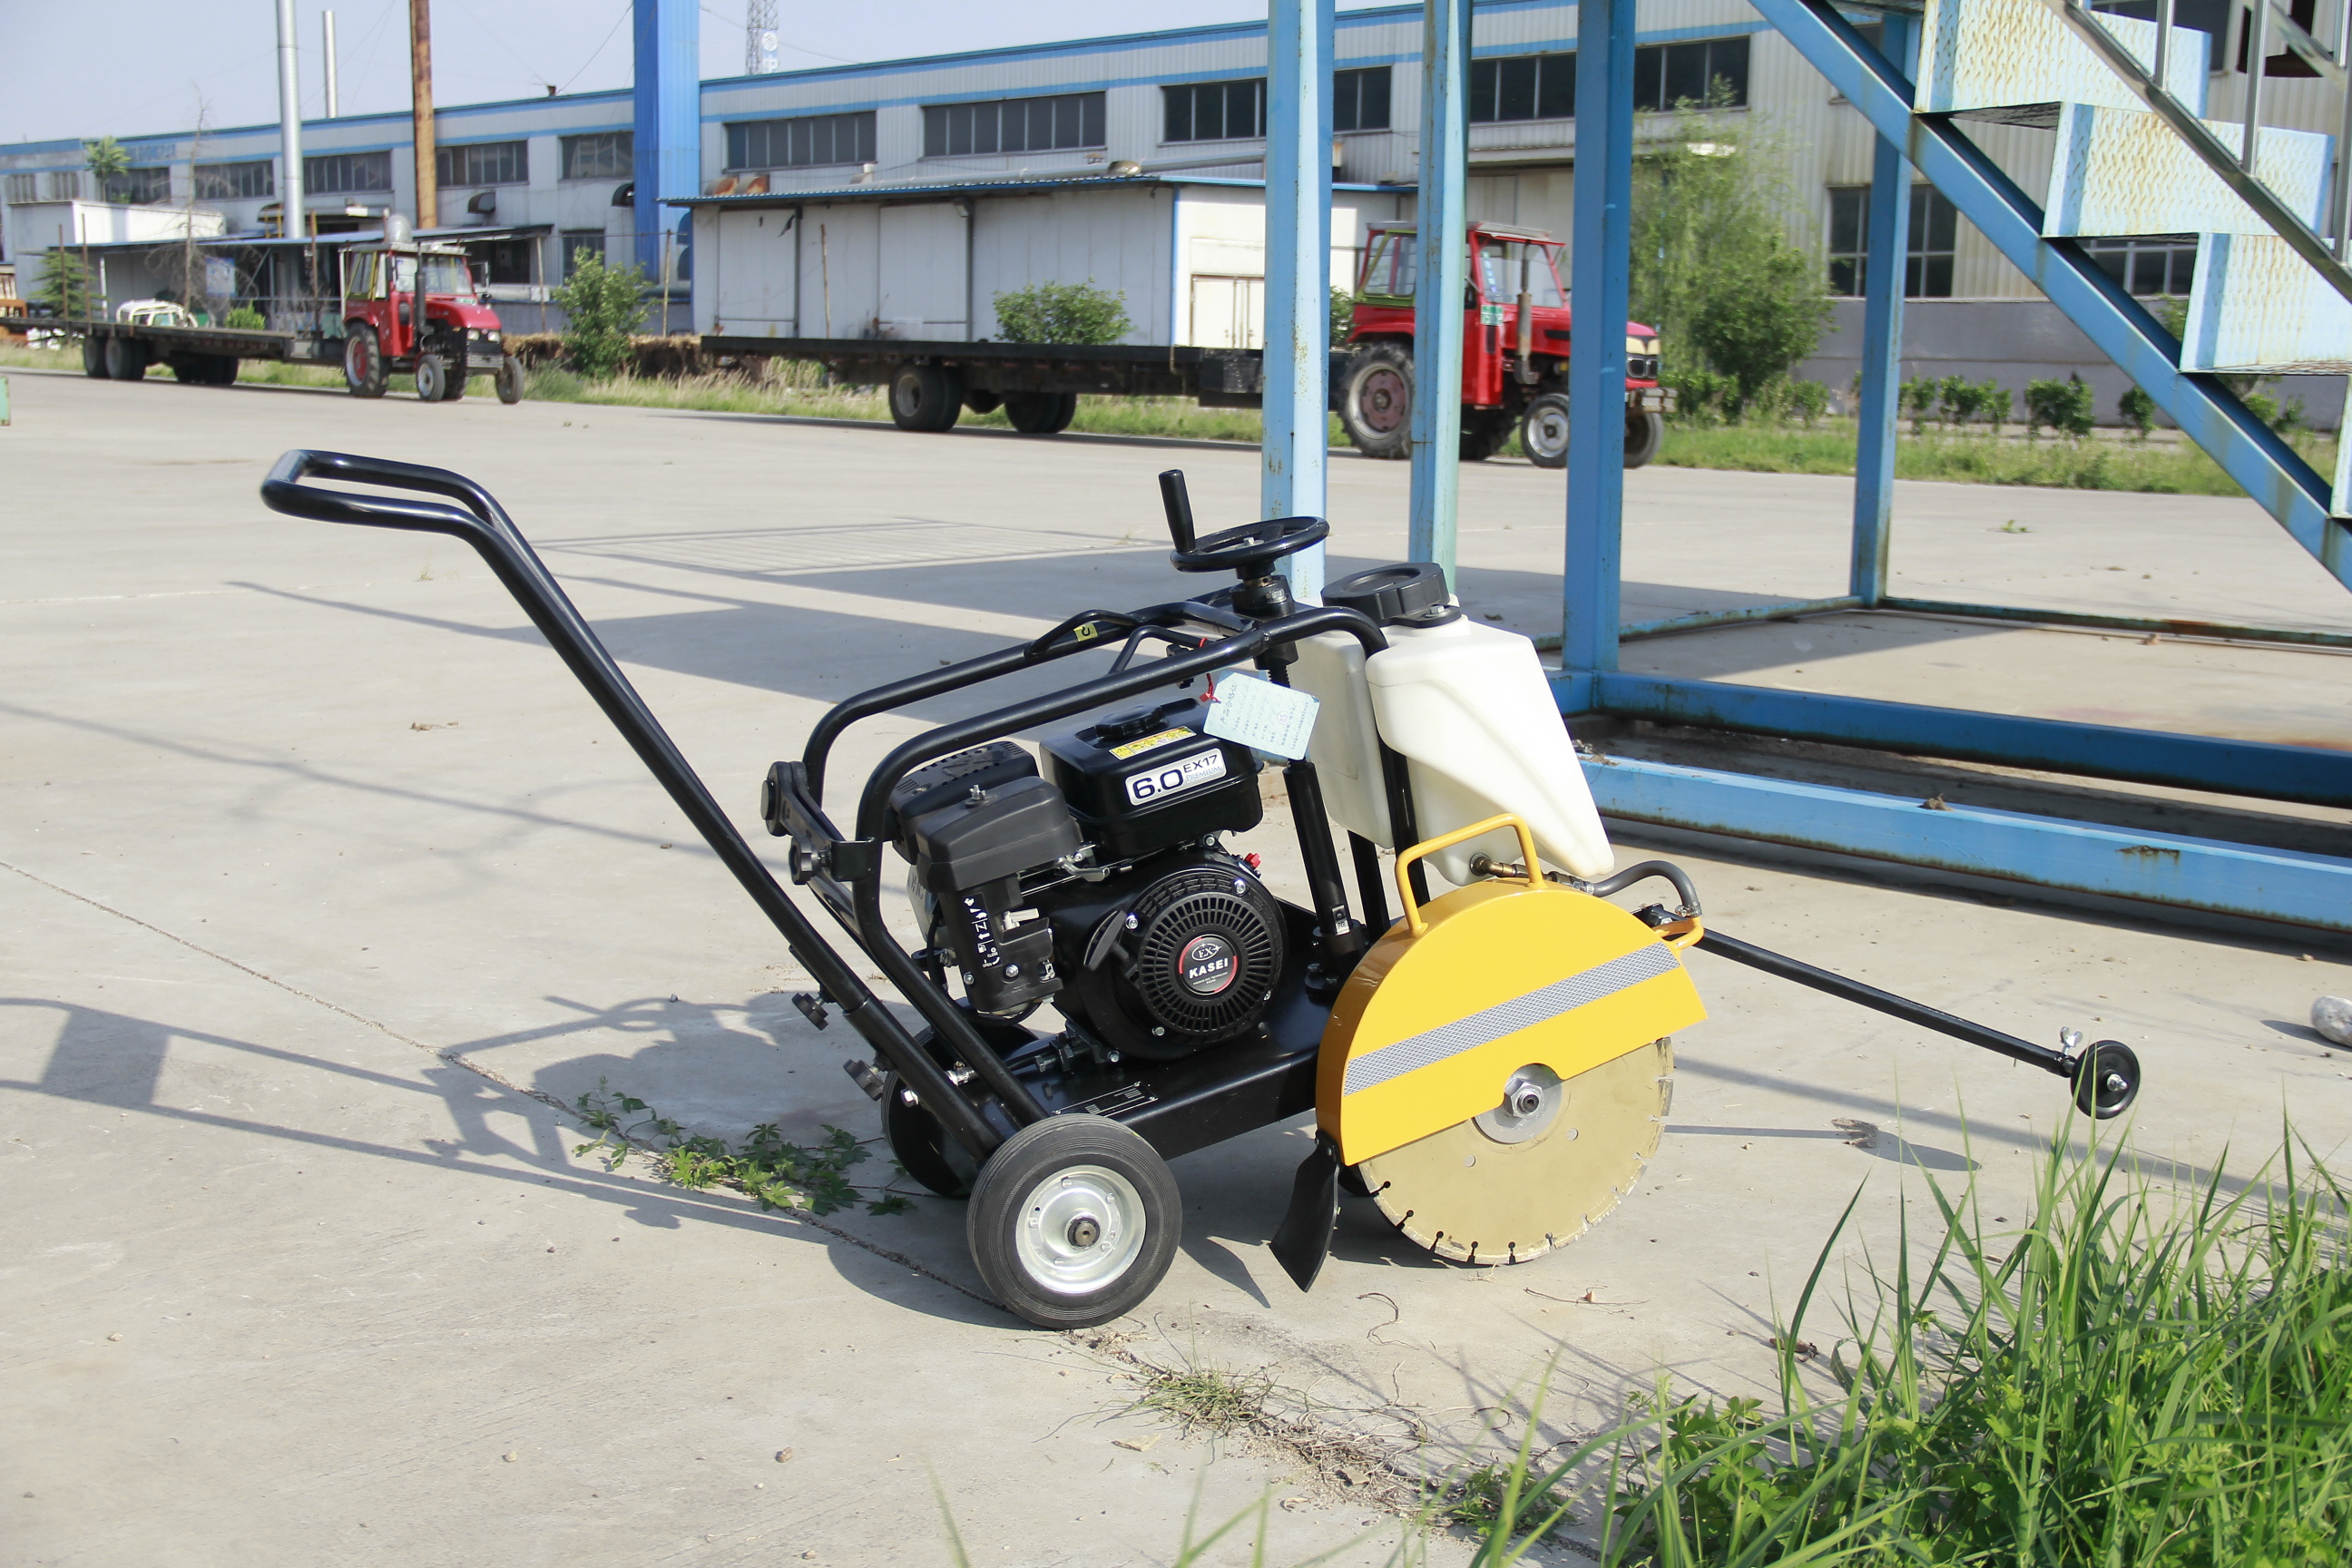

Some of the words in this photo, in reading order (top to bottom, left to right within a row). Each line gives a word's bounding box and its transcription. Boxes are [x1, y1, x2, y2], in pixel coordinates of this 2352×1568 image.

[1220, 684, 1237, 725] 产品合格证
[1132, 769, 1183, 799] 6.0
[1183, 755, 1218, 773] EX17
[1186, 766, 1222, 783] PREMIUM
[1198, 947, 1214, 958] EX
[1189, 958, 1229, 979] KASEI
